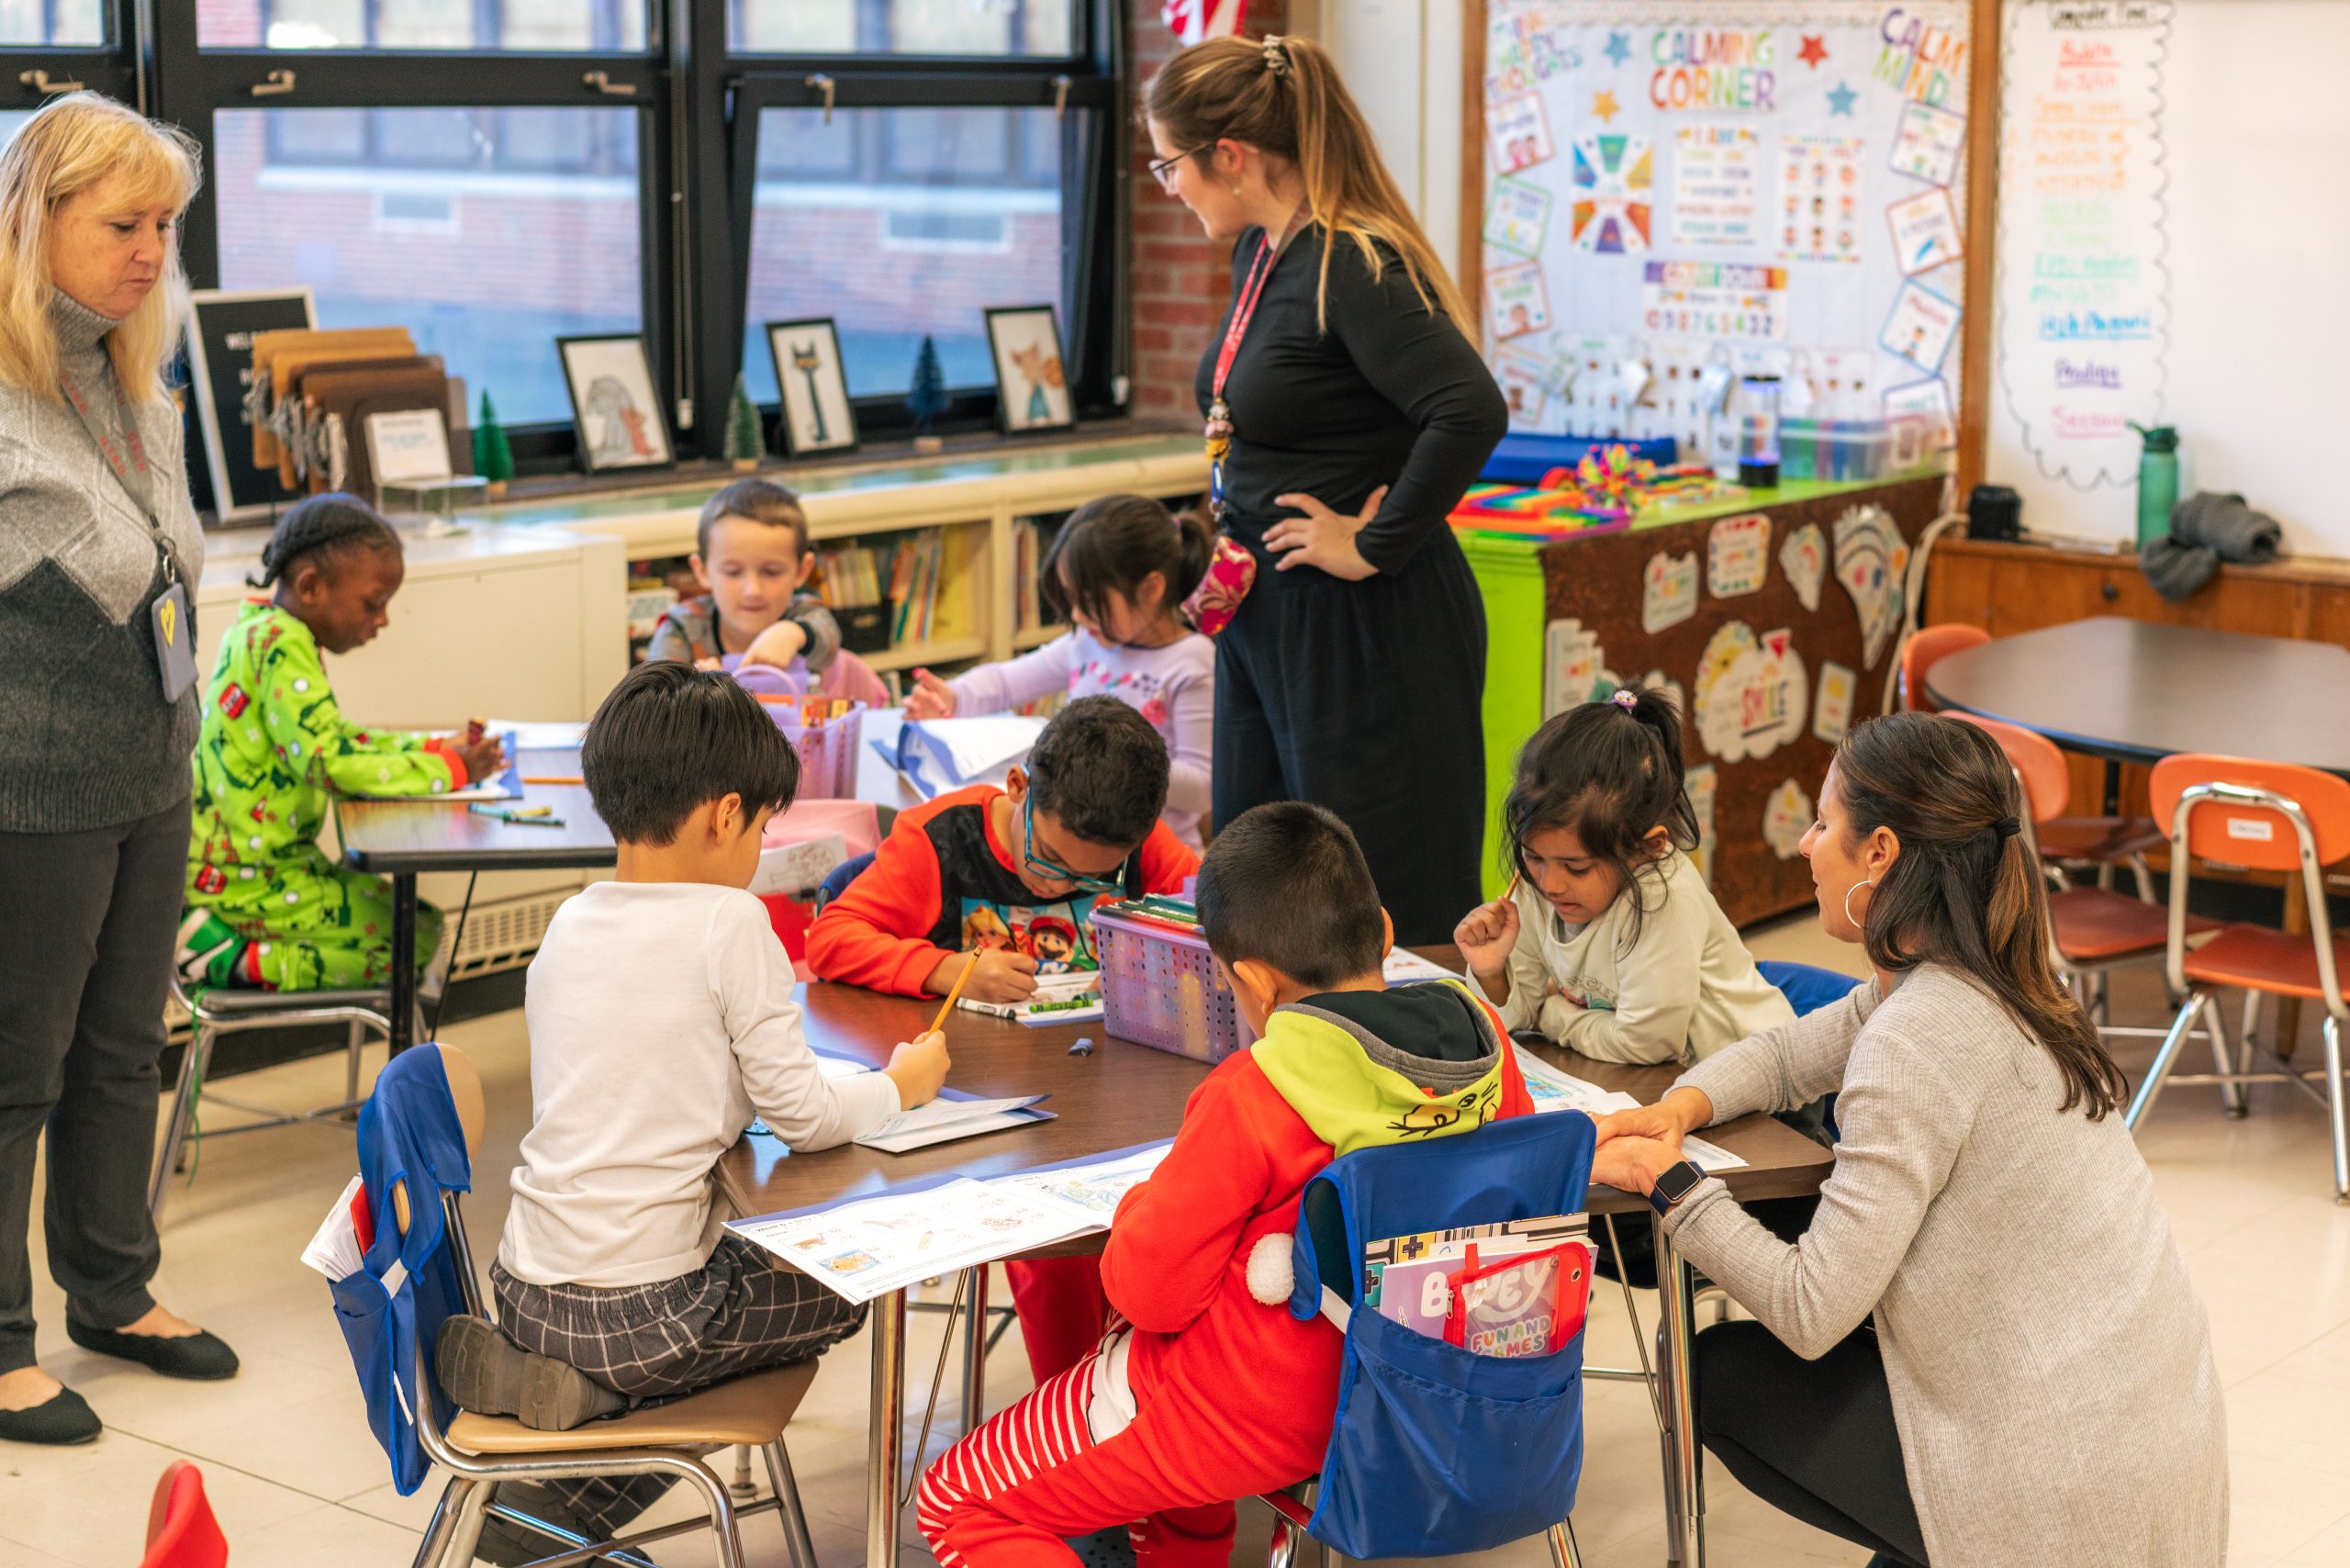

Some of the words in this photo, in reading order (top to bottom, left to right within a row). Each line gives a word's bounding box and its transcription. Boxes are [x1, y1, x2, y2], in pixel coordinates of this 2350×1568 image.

[1650, 30, 1775, 67] CALMING
[1880, 8, 1966, 73] CALM
[1649, 67, 1776, 108] CORNER
[1871, 44, 1951, 105] MIND
[1472, 1327, 1510, 1351] FUN
[1513, 1316, 1551, 1338] AND
